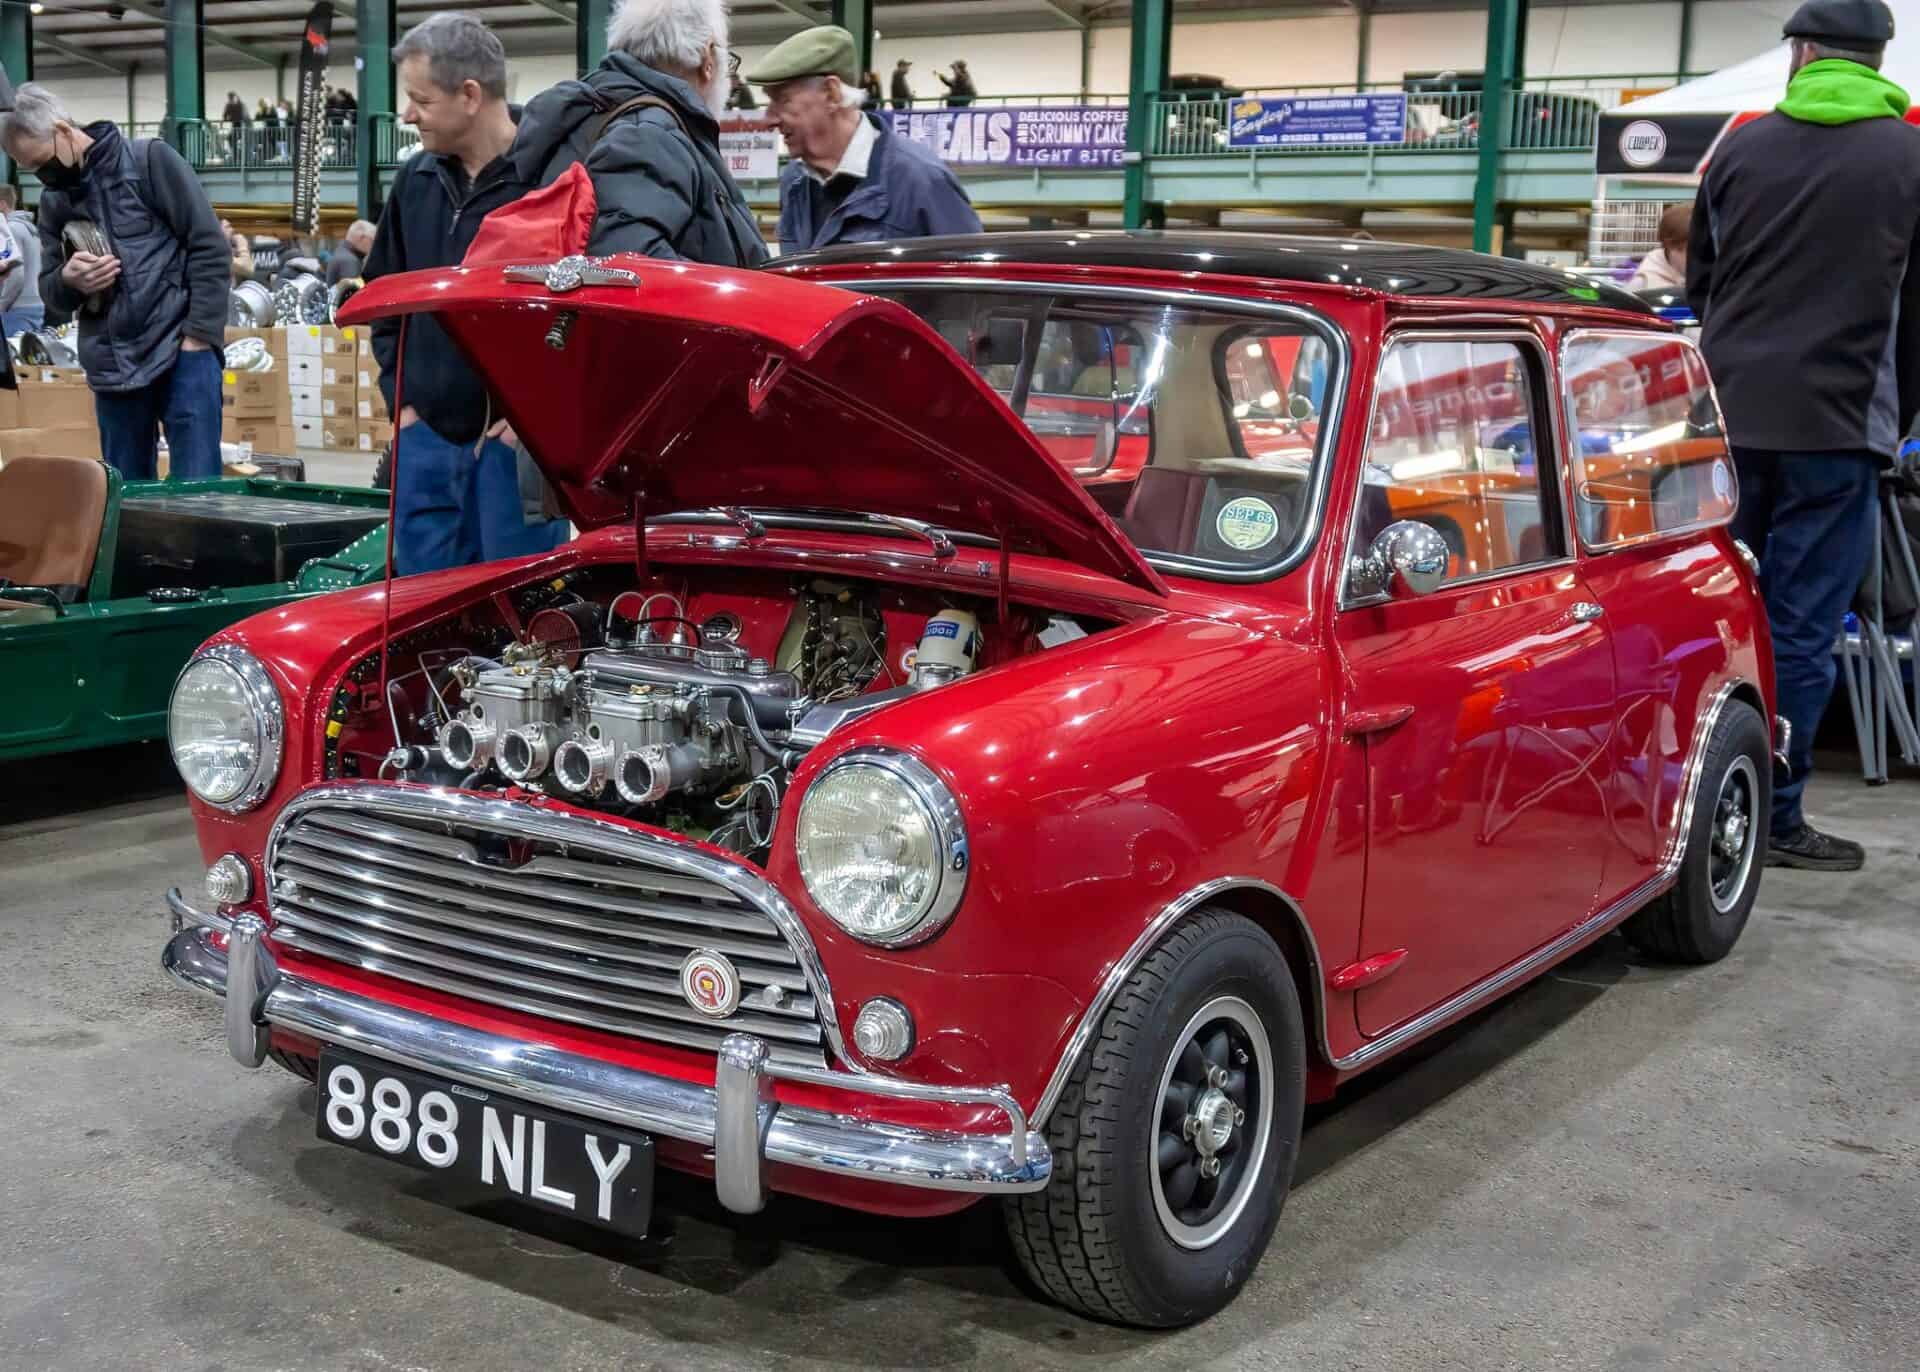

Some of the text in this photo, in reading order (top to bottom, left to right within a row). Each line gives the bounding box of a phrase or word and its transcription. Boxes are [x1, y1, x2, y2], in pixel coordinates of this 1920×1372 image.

[1018, 111, 1128, 123] DELICIOUS COFFEE
[1030, 122, 1094, 144] SCRUMMY
[1627, 135, 1661, 151] COOPER
[1016, 147, 1074, 163] LIGHT
[1225, 505, 1273, 524] SEP 63
[325, 1063, 632, 1222] 888 NLY
